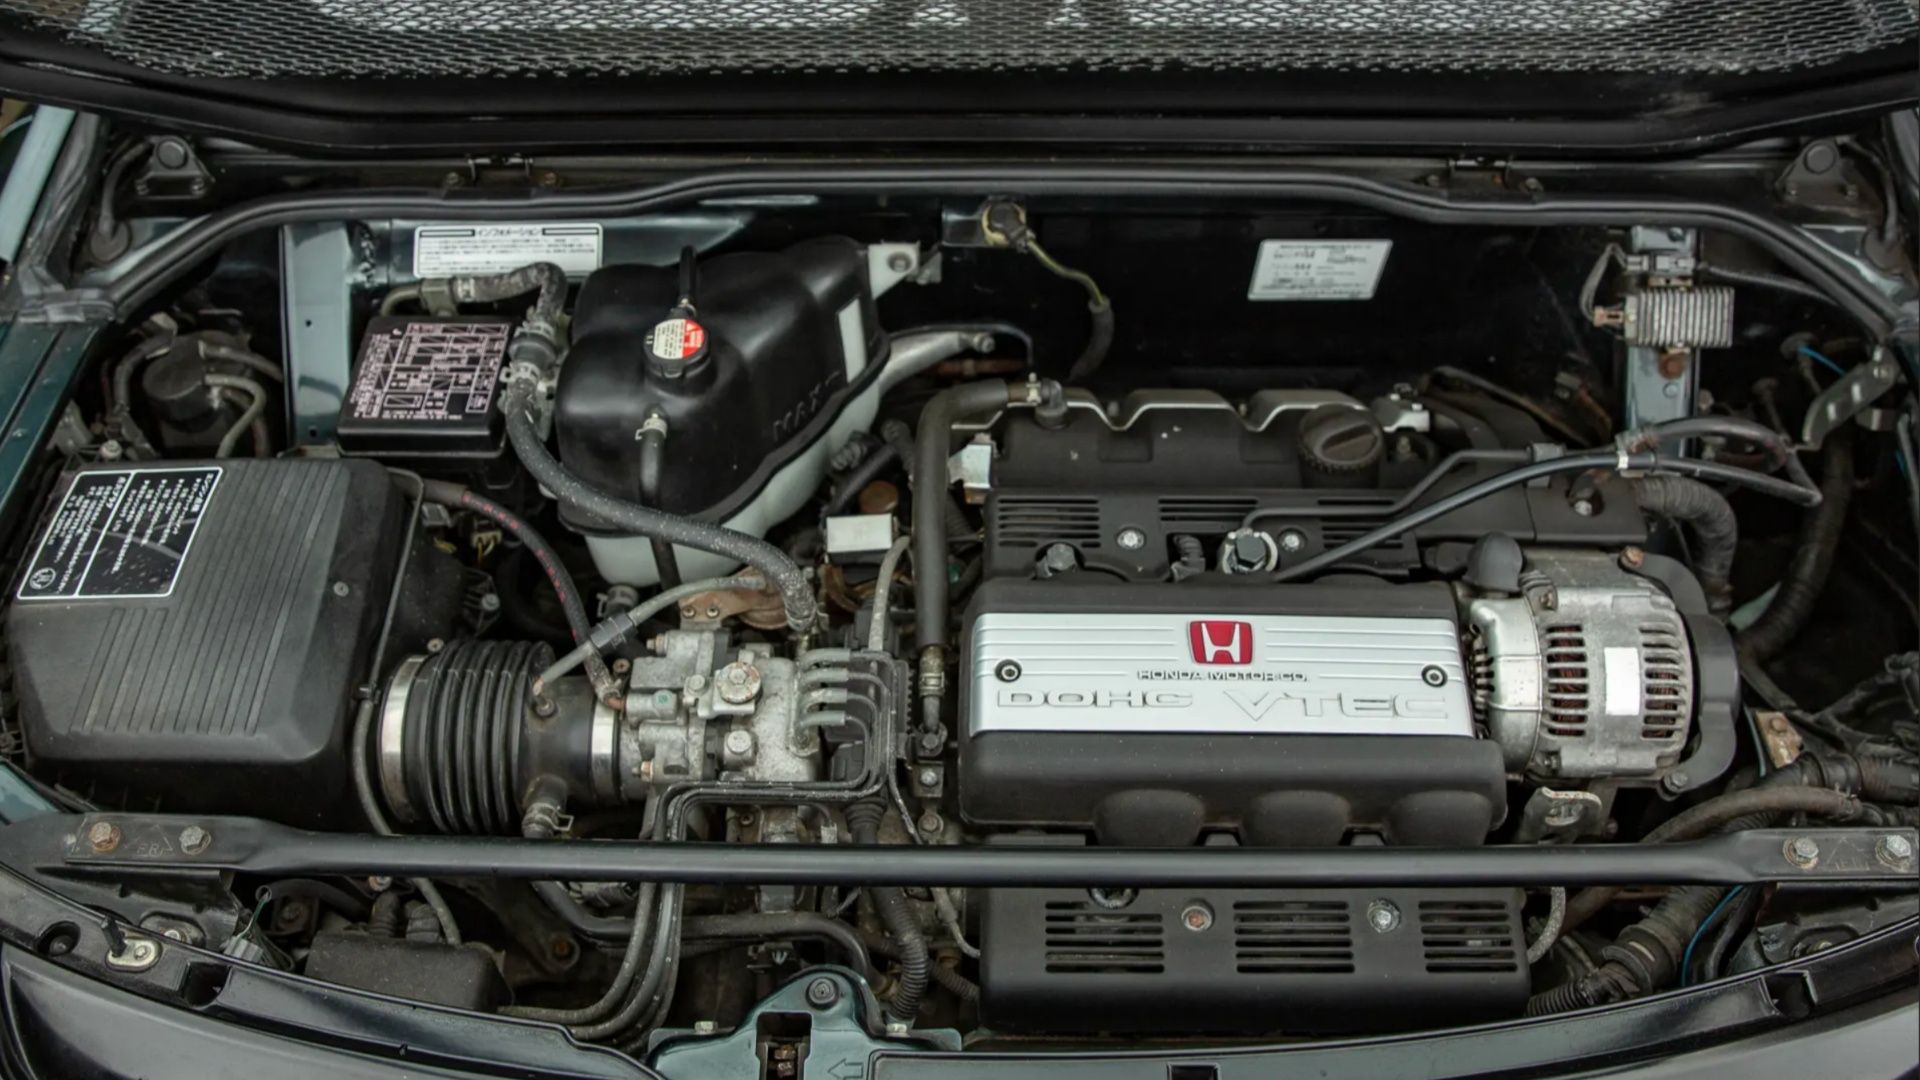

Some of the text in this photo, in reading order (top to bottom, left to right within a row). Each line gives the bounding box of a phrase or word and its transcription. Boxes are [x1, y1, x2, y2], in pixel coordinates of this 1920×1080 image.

[1137, 670, 1202, 681] HONDA
[1208, 671, 1274, 682] MOTOR
[997, 689, 1449, 722] DOHC VTEC
